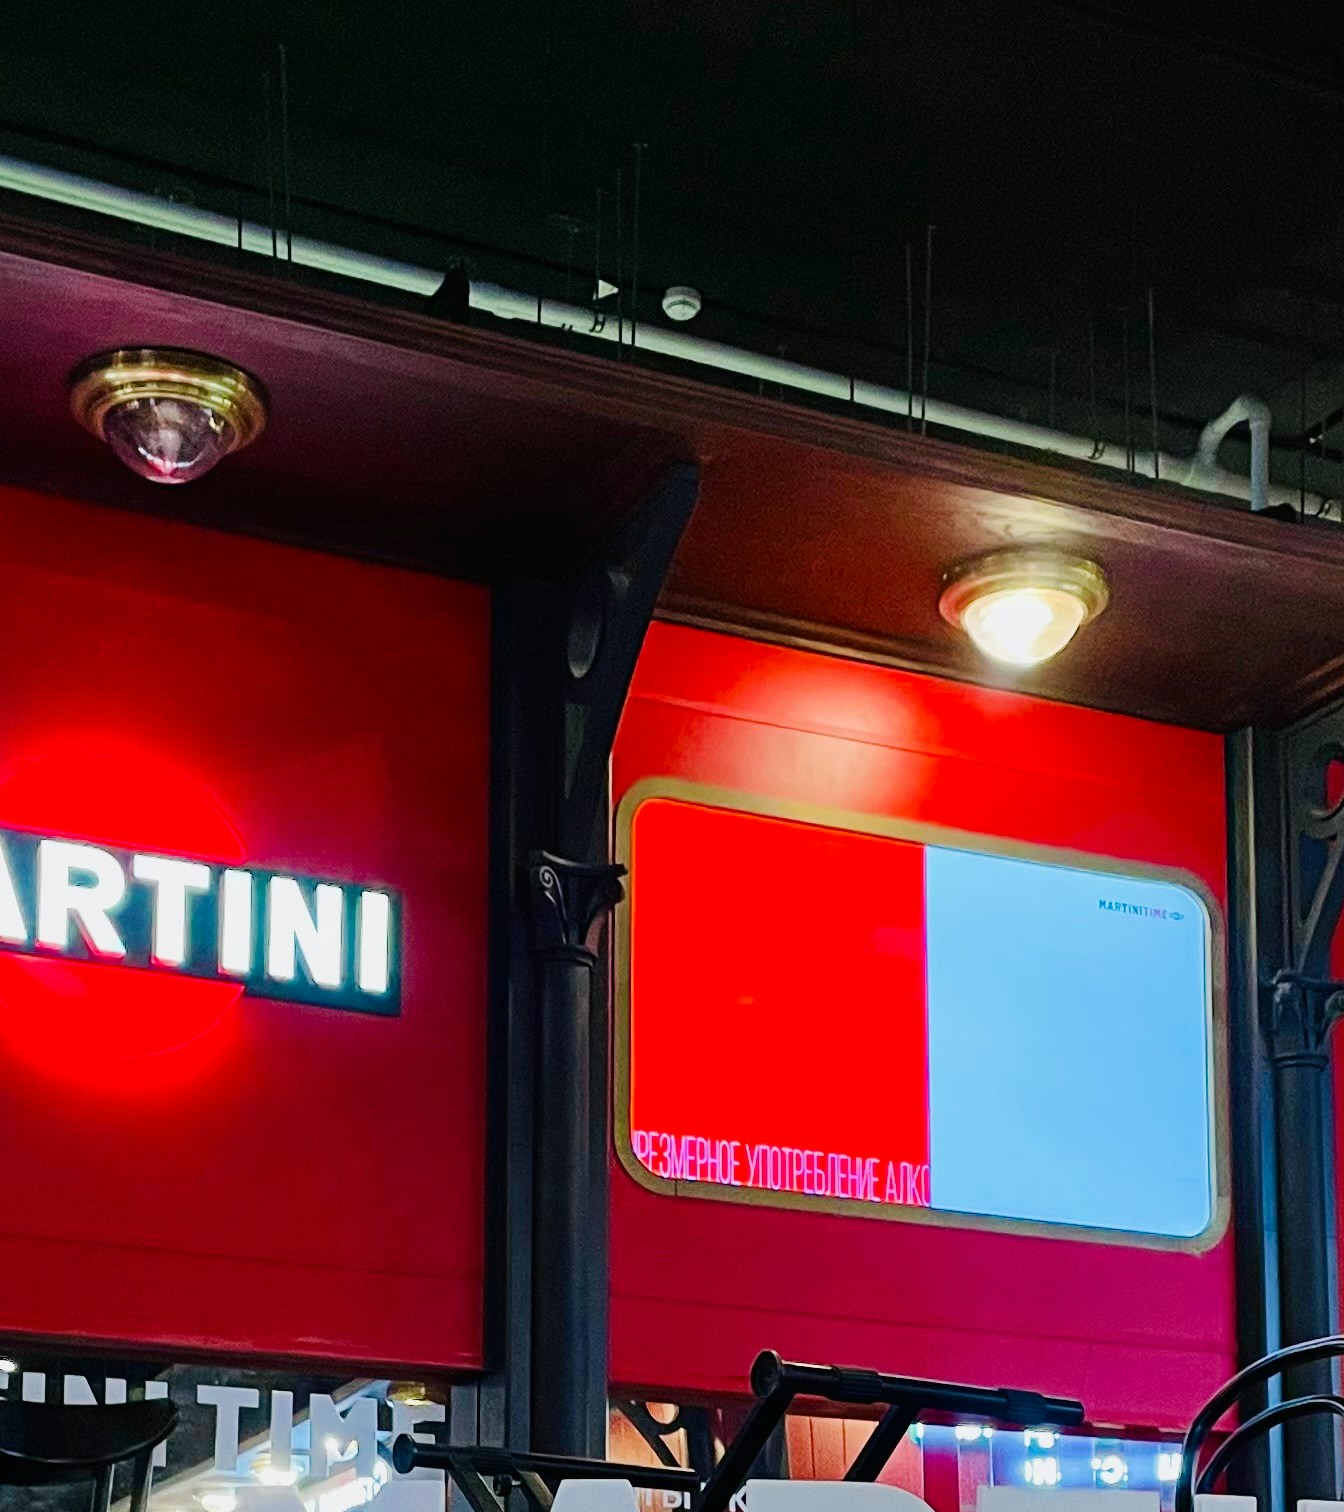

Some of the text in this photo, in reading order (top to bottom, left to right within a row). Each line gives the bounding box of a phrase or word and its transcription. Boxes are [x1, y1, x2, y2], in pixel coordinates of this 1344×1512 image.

[745, 1143, 881, 1203] УПОТРЕБЛЕНИЕ
[884, 1160, 931, 1208] АЛКО
[196, 1383, 446, 1480] TIME
